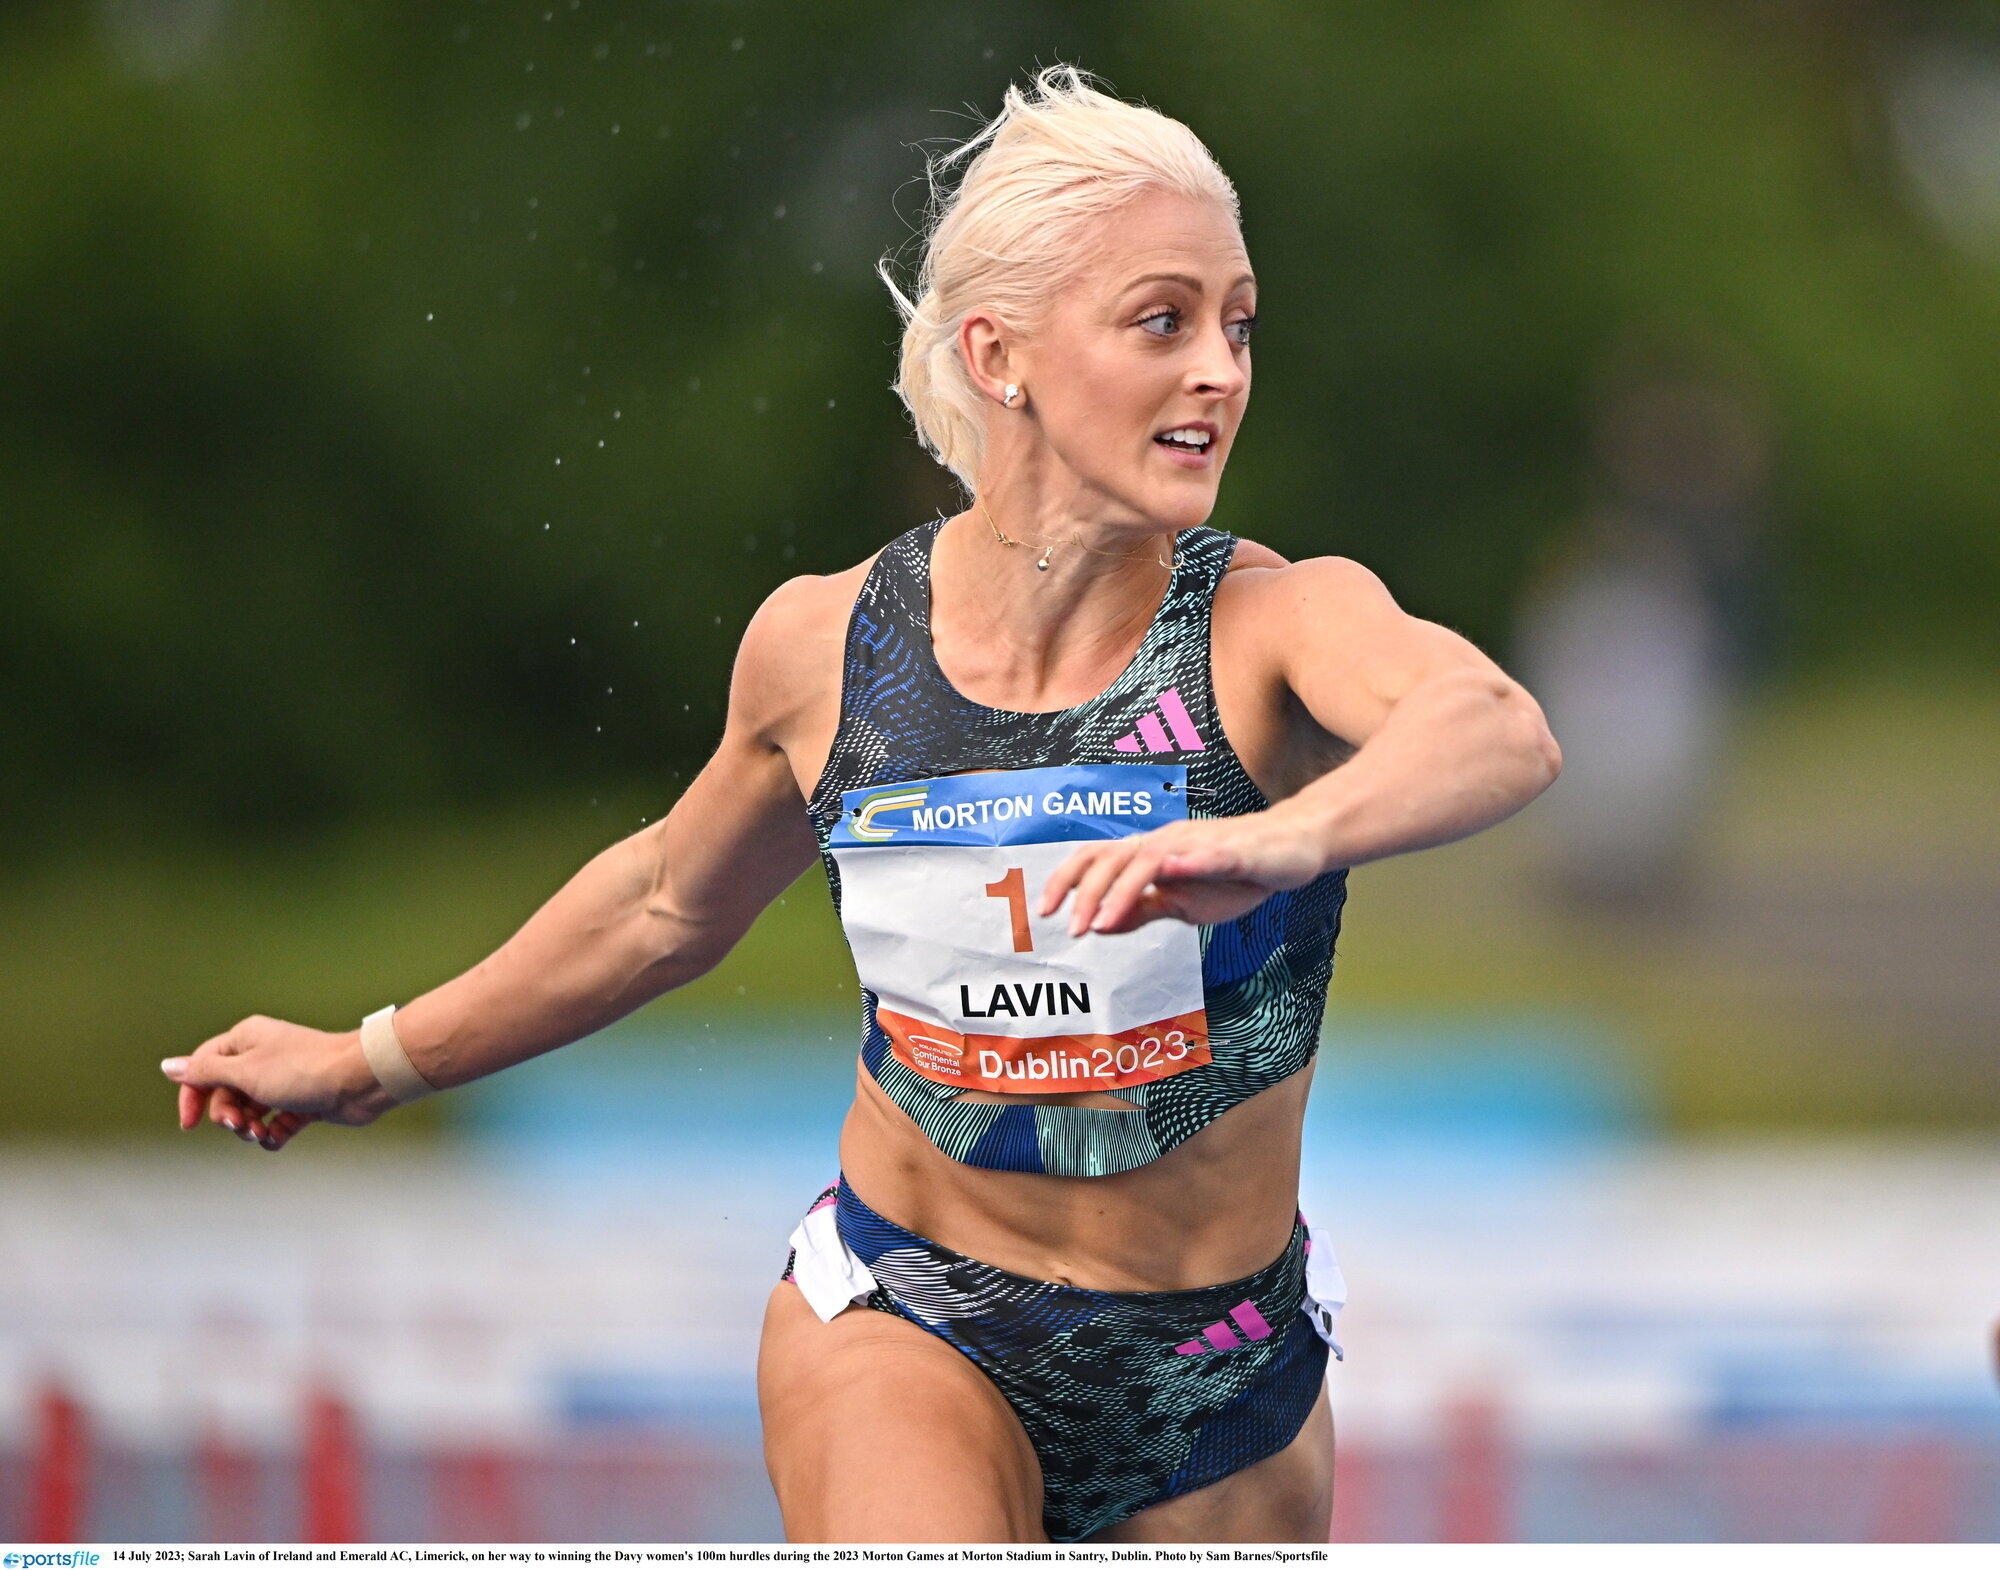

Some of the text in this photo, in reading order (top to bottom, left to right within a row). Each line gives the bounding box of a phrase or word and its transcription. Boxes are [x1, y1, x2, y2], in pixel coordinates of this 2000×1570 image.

[912, 791, 1152, 831] MORTON GAMES
[985, 868, 1034, 953] 1
[960, 982, 1091, 1018] LAVIN
[912, 1047, 960, 1067] Continental
[913, 1056, 961, 1076] Tour Bronze
